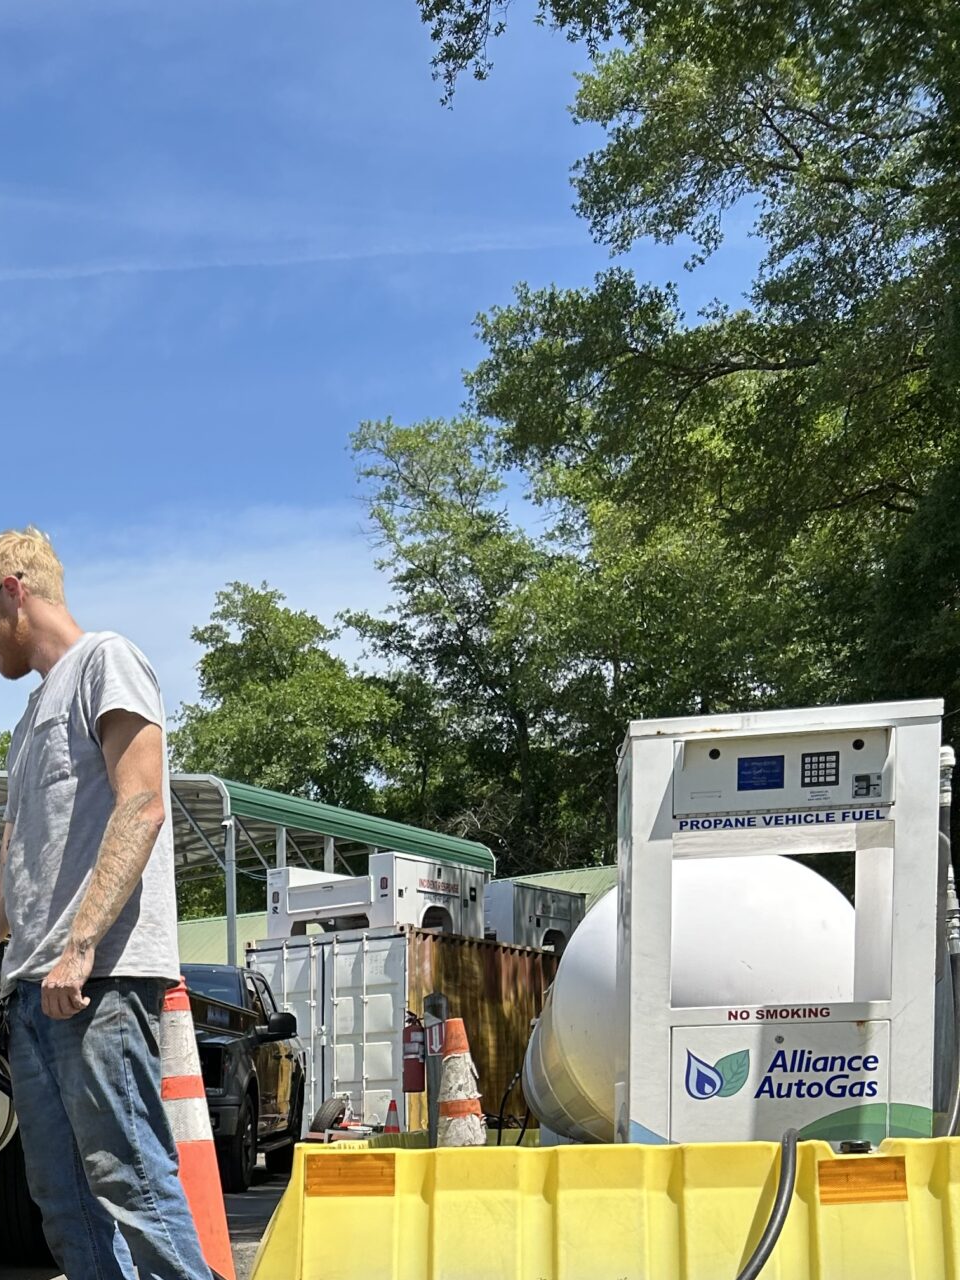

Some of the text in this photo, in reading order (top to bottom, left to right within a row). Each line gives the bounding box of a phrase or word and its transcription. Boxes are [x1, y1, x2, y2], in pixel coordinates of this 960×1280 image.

[679, 809, 885, 831] PROPANE VEHICLE FUEL
[728, 1007, 831, 1021] NO SMOKING
[767, 1050, 879, 1073] Alliance
[754, 1074, 878, 1099] AutoGas
